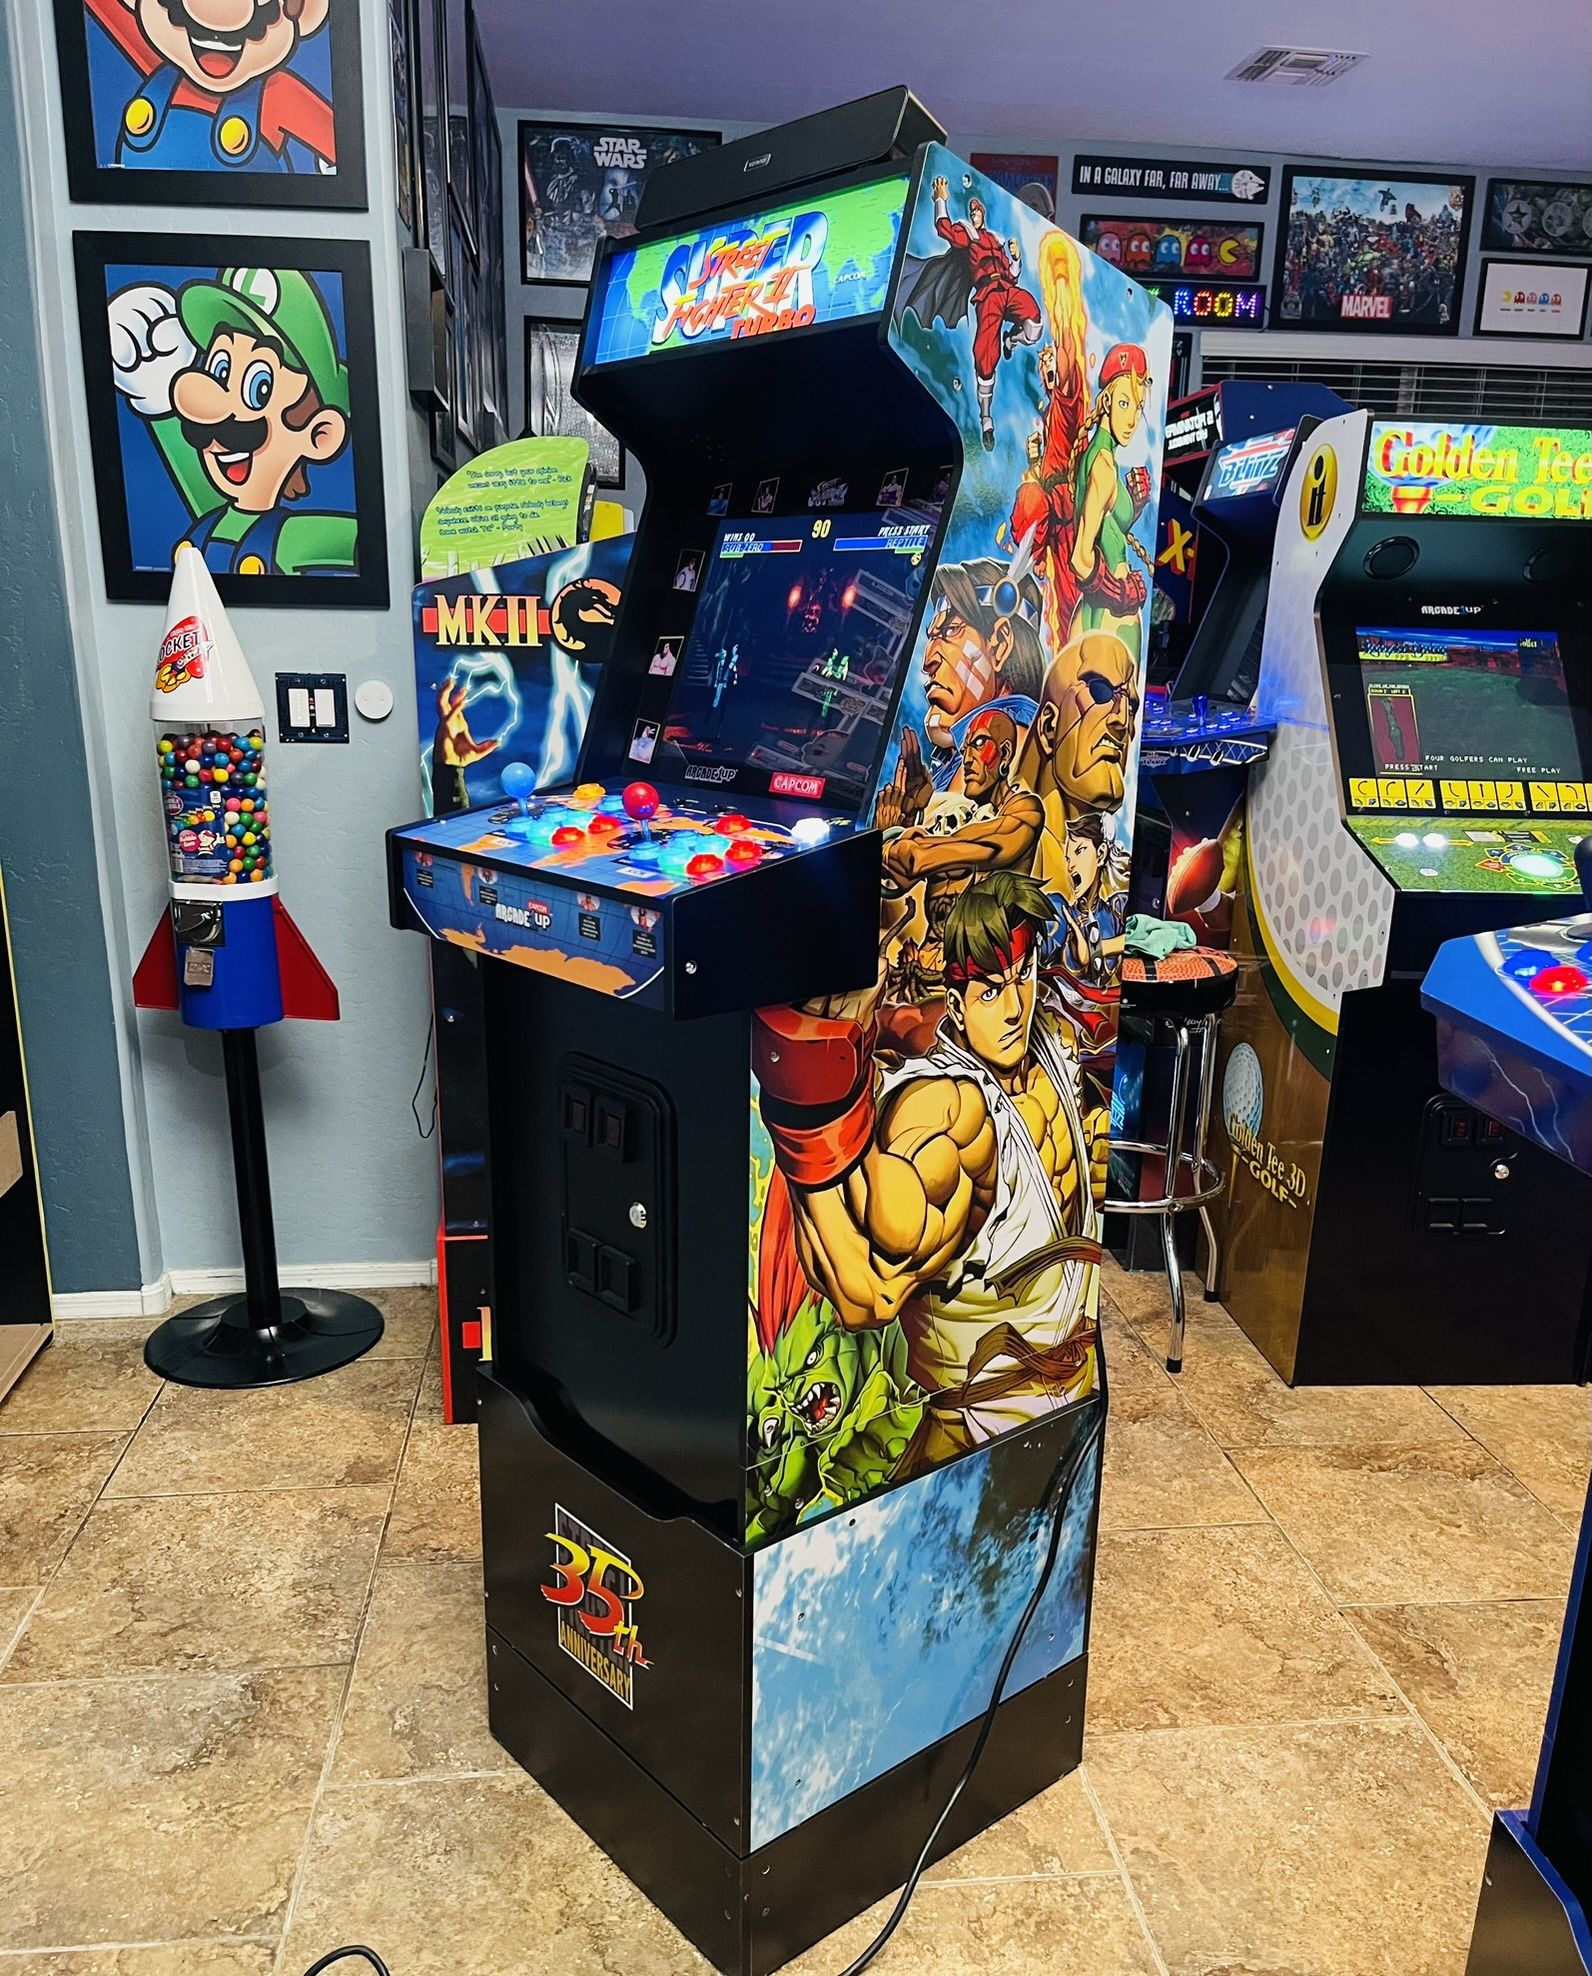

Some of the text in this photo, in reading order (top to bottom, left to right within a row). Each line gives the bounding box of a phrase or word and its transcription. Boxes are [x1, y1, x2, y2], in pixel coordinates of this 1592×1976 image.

[594, 137, 647, 154] STAR
[594, 152, 647, 168] WARS
[1079, 165, 1091, 184] IN
[1094, 166, 1102, 184] A
[1104, 167, 1142, 187] GALAXY
[1144, 169, 1166, 190] FAR,
[1169, 171, 1189, 189] FAR
[688, 228, 790, 291] STREET
[651, 211, 828, 345] SUPER
[833, 271, 869, 285] CAPCOM
[662, 264, 812, 340] FIGHTER II
[1174, 288, 1257, 318] ROOM
[1341, 295, 1391, 318] MARVEL
[730, 304, 817, 340] TURBO
[1218, 446, 1290, 487] BLITZ
[1372, 430, 1520, 483] Golden
[723, 533, 743, 542] WINS
[811, 519, 831, 538] 90
[877, 524, 931, 537] PRESS START
[886, 538, 924, 548] REPTILE
[433, 594, 543, 647] MKII
[774, 776, 819, 793] CAPCOM
[1266, 1142, 1285, 1180] Tee
[1287, 1163, 1306, 1198] 3D
[559, 1620, 632, 1702] ANNIVERSARY
